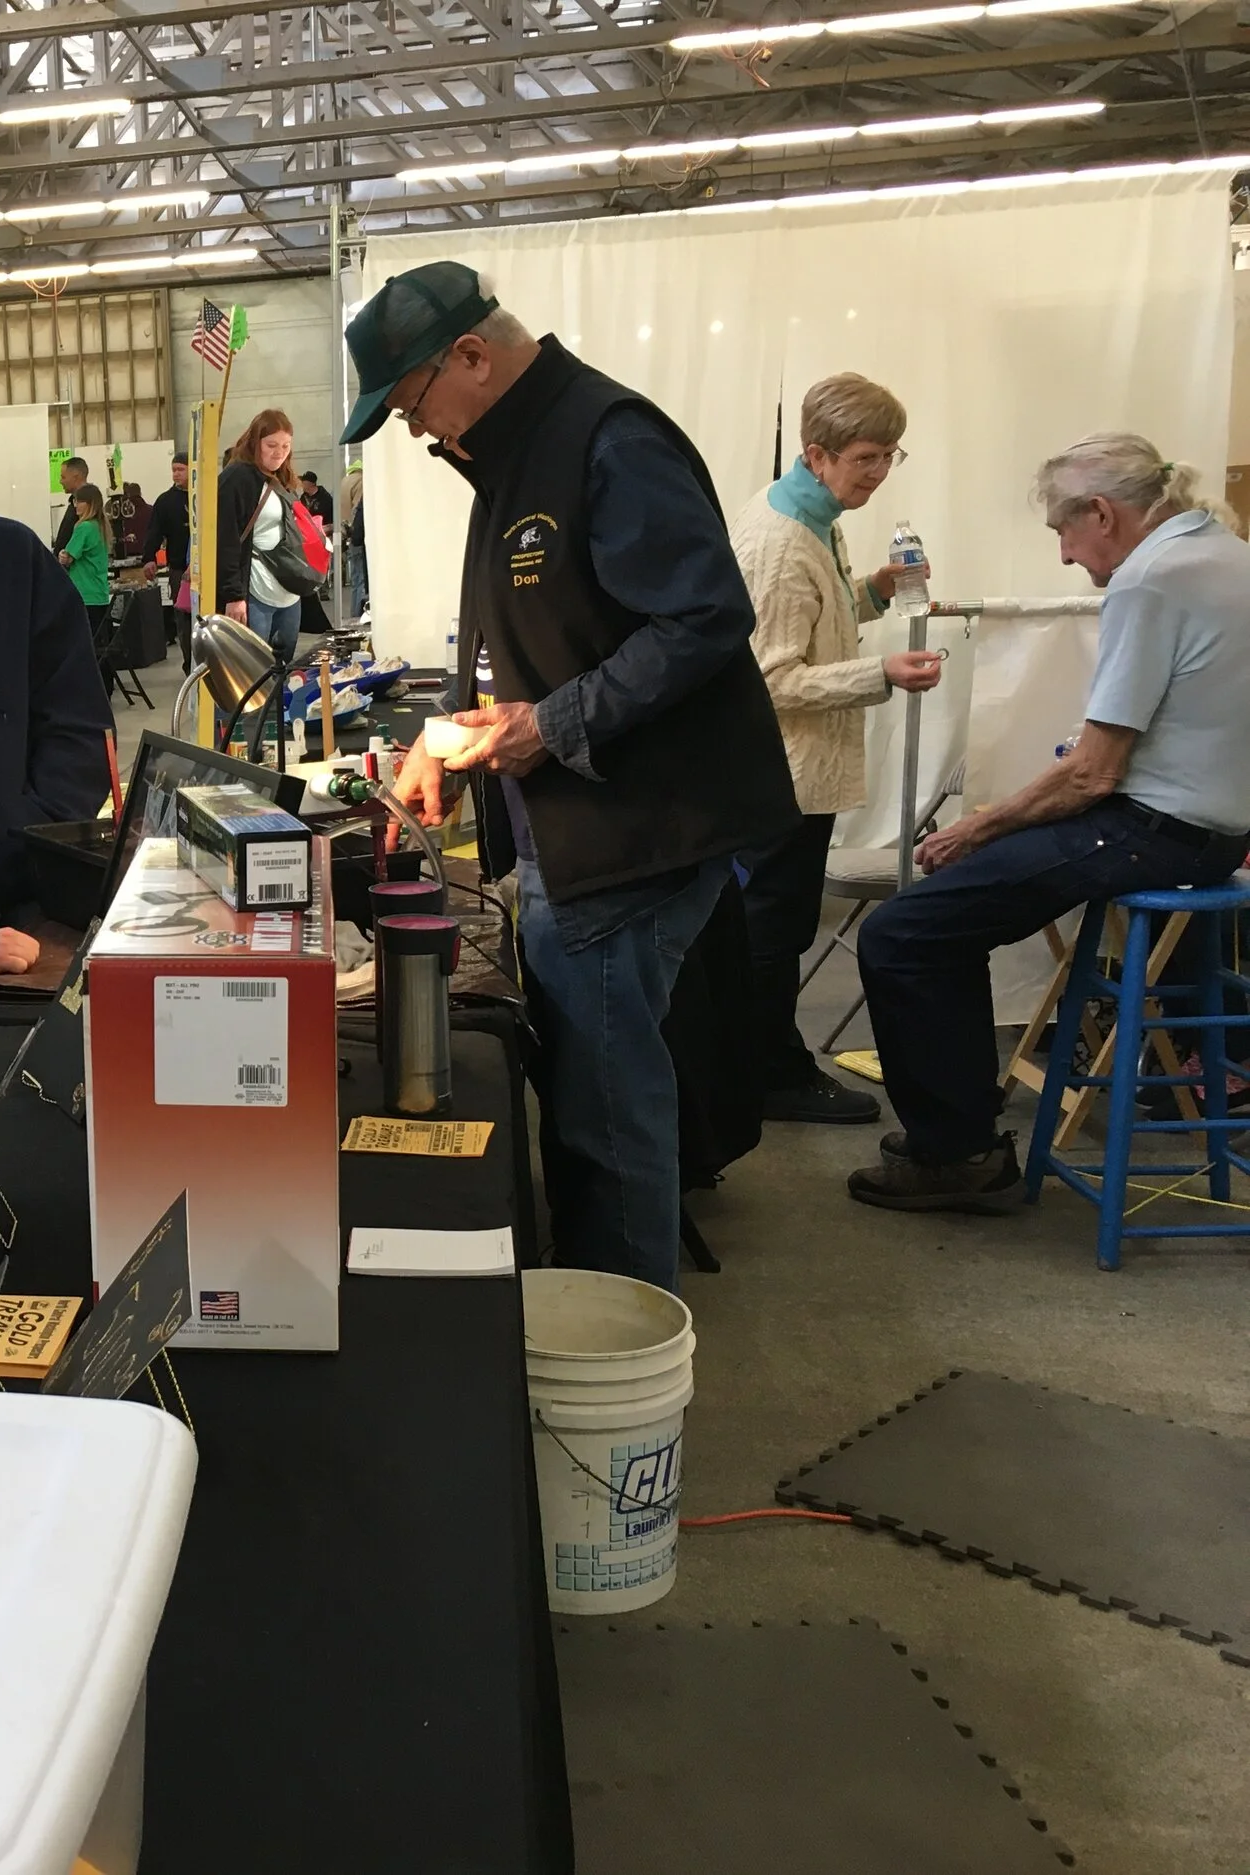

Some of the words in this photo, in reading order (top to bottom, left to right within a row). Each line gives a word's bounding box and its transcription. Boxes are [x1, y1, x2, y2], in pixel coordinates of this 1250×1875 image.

[513, 574, 540, 587] Don
[8, 1311, 45, 1346] GOLD
[625, 1511, 671, 1538] Laundry
